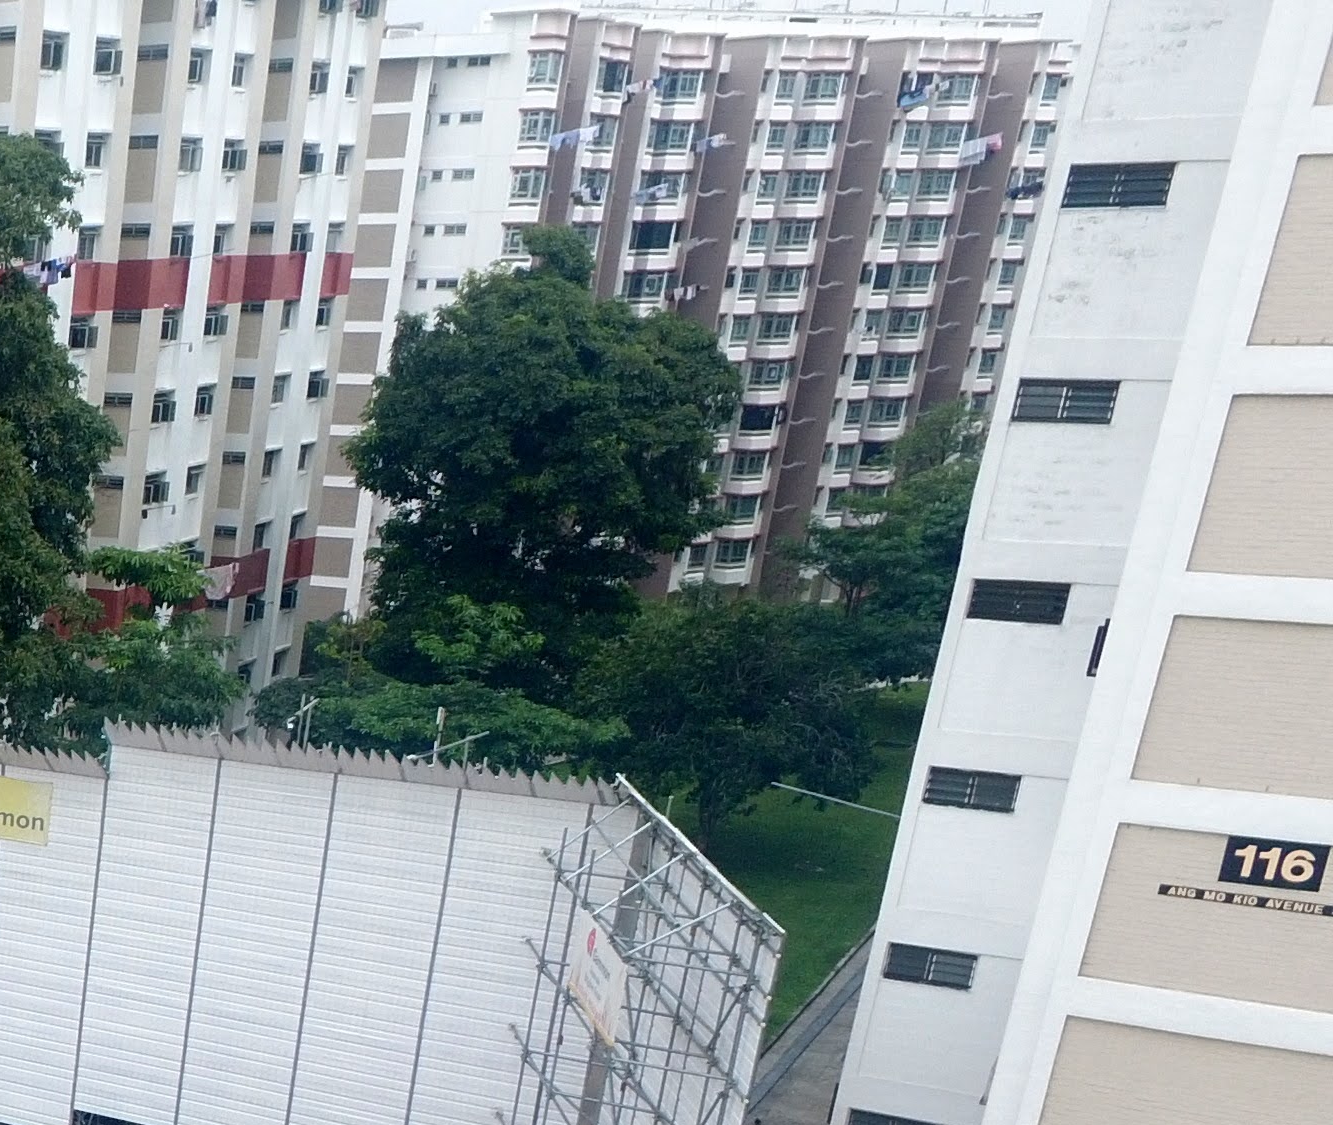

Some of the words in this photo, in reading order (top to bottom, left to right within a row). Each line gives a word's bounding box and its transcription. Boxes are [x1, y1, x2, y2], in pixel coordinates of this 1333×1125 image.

[1234, 844, 1316, 883] 116
[1166, 886, 1197, 898] ANG
[1203, 890, 1226, 902] MO
[1232, 894, 1258, 906] KIO
[1265, 898, 1325, 915] AVENUE
